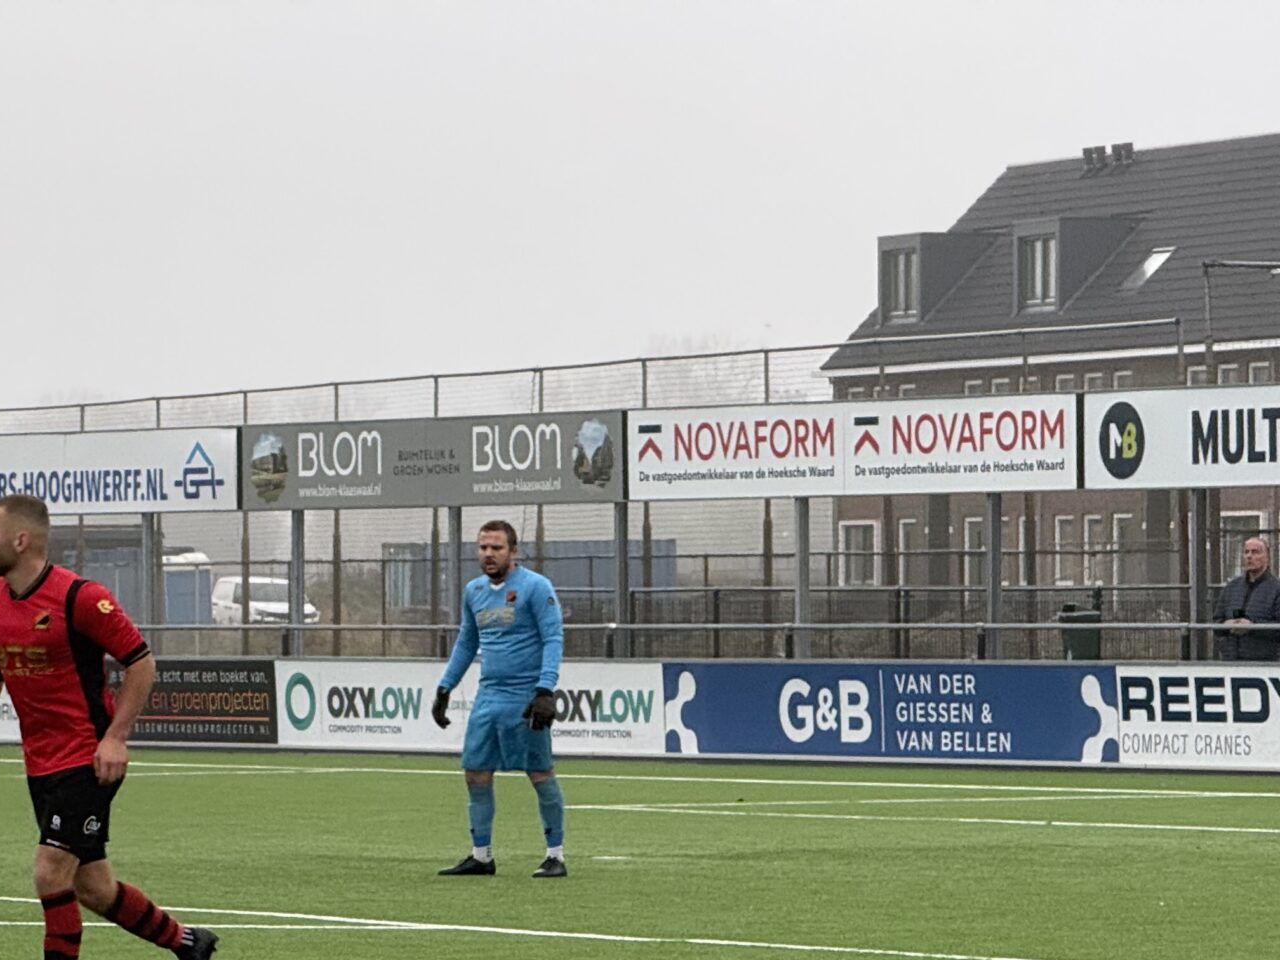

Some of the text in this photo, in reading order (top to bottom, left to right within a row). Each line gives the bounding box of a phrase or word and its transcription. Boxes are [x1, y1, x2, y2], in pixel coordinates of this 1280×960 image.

[674, 418, 835, 462] NOVAFORM
[892, 409, 1064, 455] NOVAFORM
[298, 430, 382, 477] BLOM
[472, 423, 561, 472] BLOM
[639, 465, 835, 484] De vastgoedontwikkelaar van de Hoeksche Waard
[855, 458, 1065, 479] De vastgoedontwikkelaar van de Hoeksche Waard
[894, 673, 976, 695] VAN DER
[171, 687, 269, 713] groenprojecten
[327, 686, 423, 720] OXYLOW
[553, 688, 654, 723] OXYLOW
[778, 677, 872, 743] G&B
[1120, 676, 1280, 723] REED
[896, 702, 993, 724] GIESSEN &
[365, 725, 402, 734] PROTECTION
[591, 729, 632, 738] PROTECTION
[896, 730, 1011, 752] VAN BELLEN
[1122, 733, 1252, 756] COMPACT CRANES
